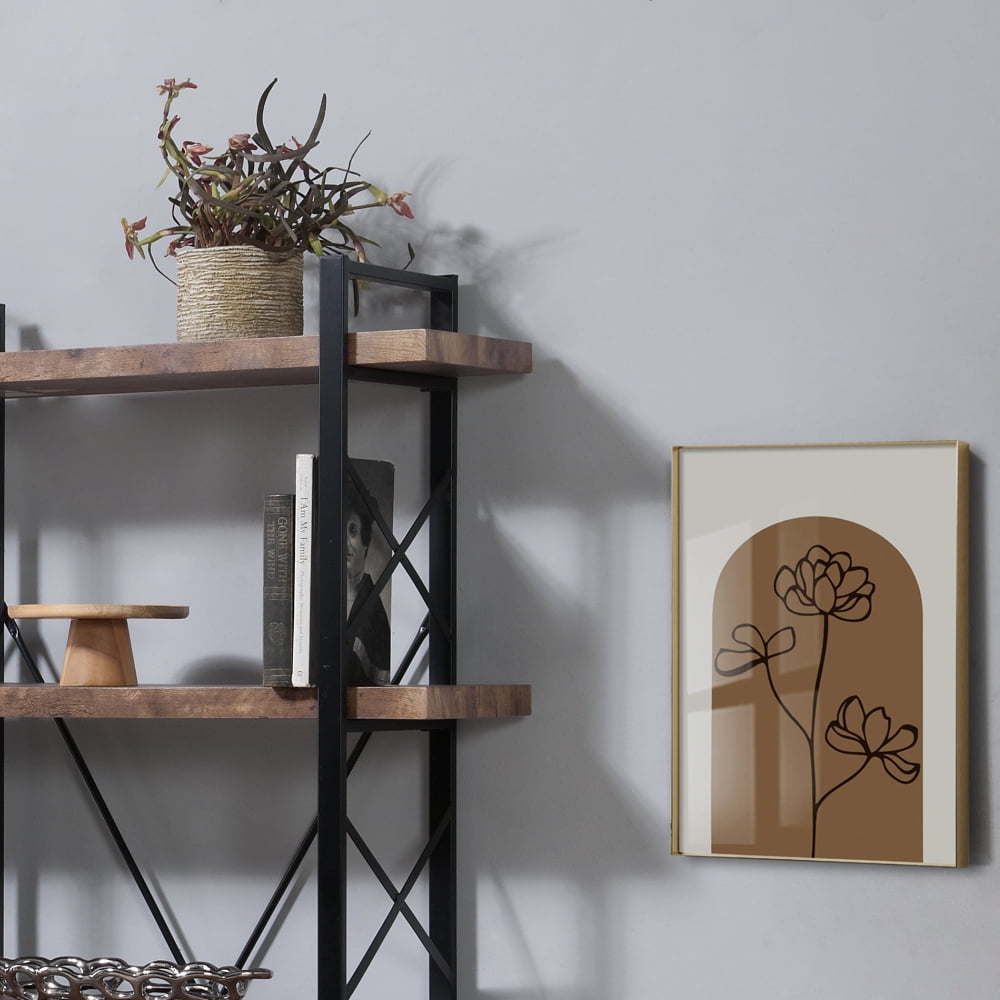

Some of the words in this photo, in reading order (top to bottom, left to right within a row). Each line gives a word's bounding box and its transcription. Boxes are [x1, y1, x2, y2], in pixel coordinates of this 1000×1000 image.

[299, 502, 309, 518] Am
[267, 521, 276, 545] THE
[277, 516, 288, 548] GONE
[297, 521, 308, 533] My
[266, 548, 275, 579] WIND
[297, 537, 308, 565] Family
[277, 552, 288, 582] WITH
